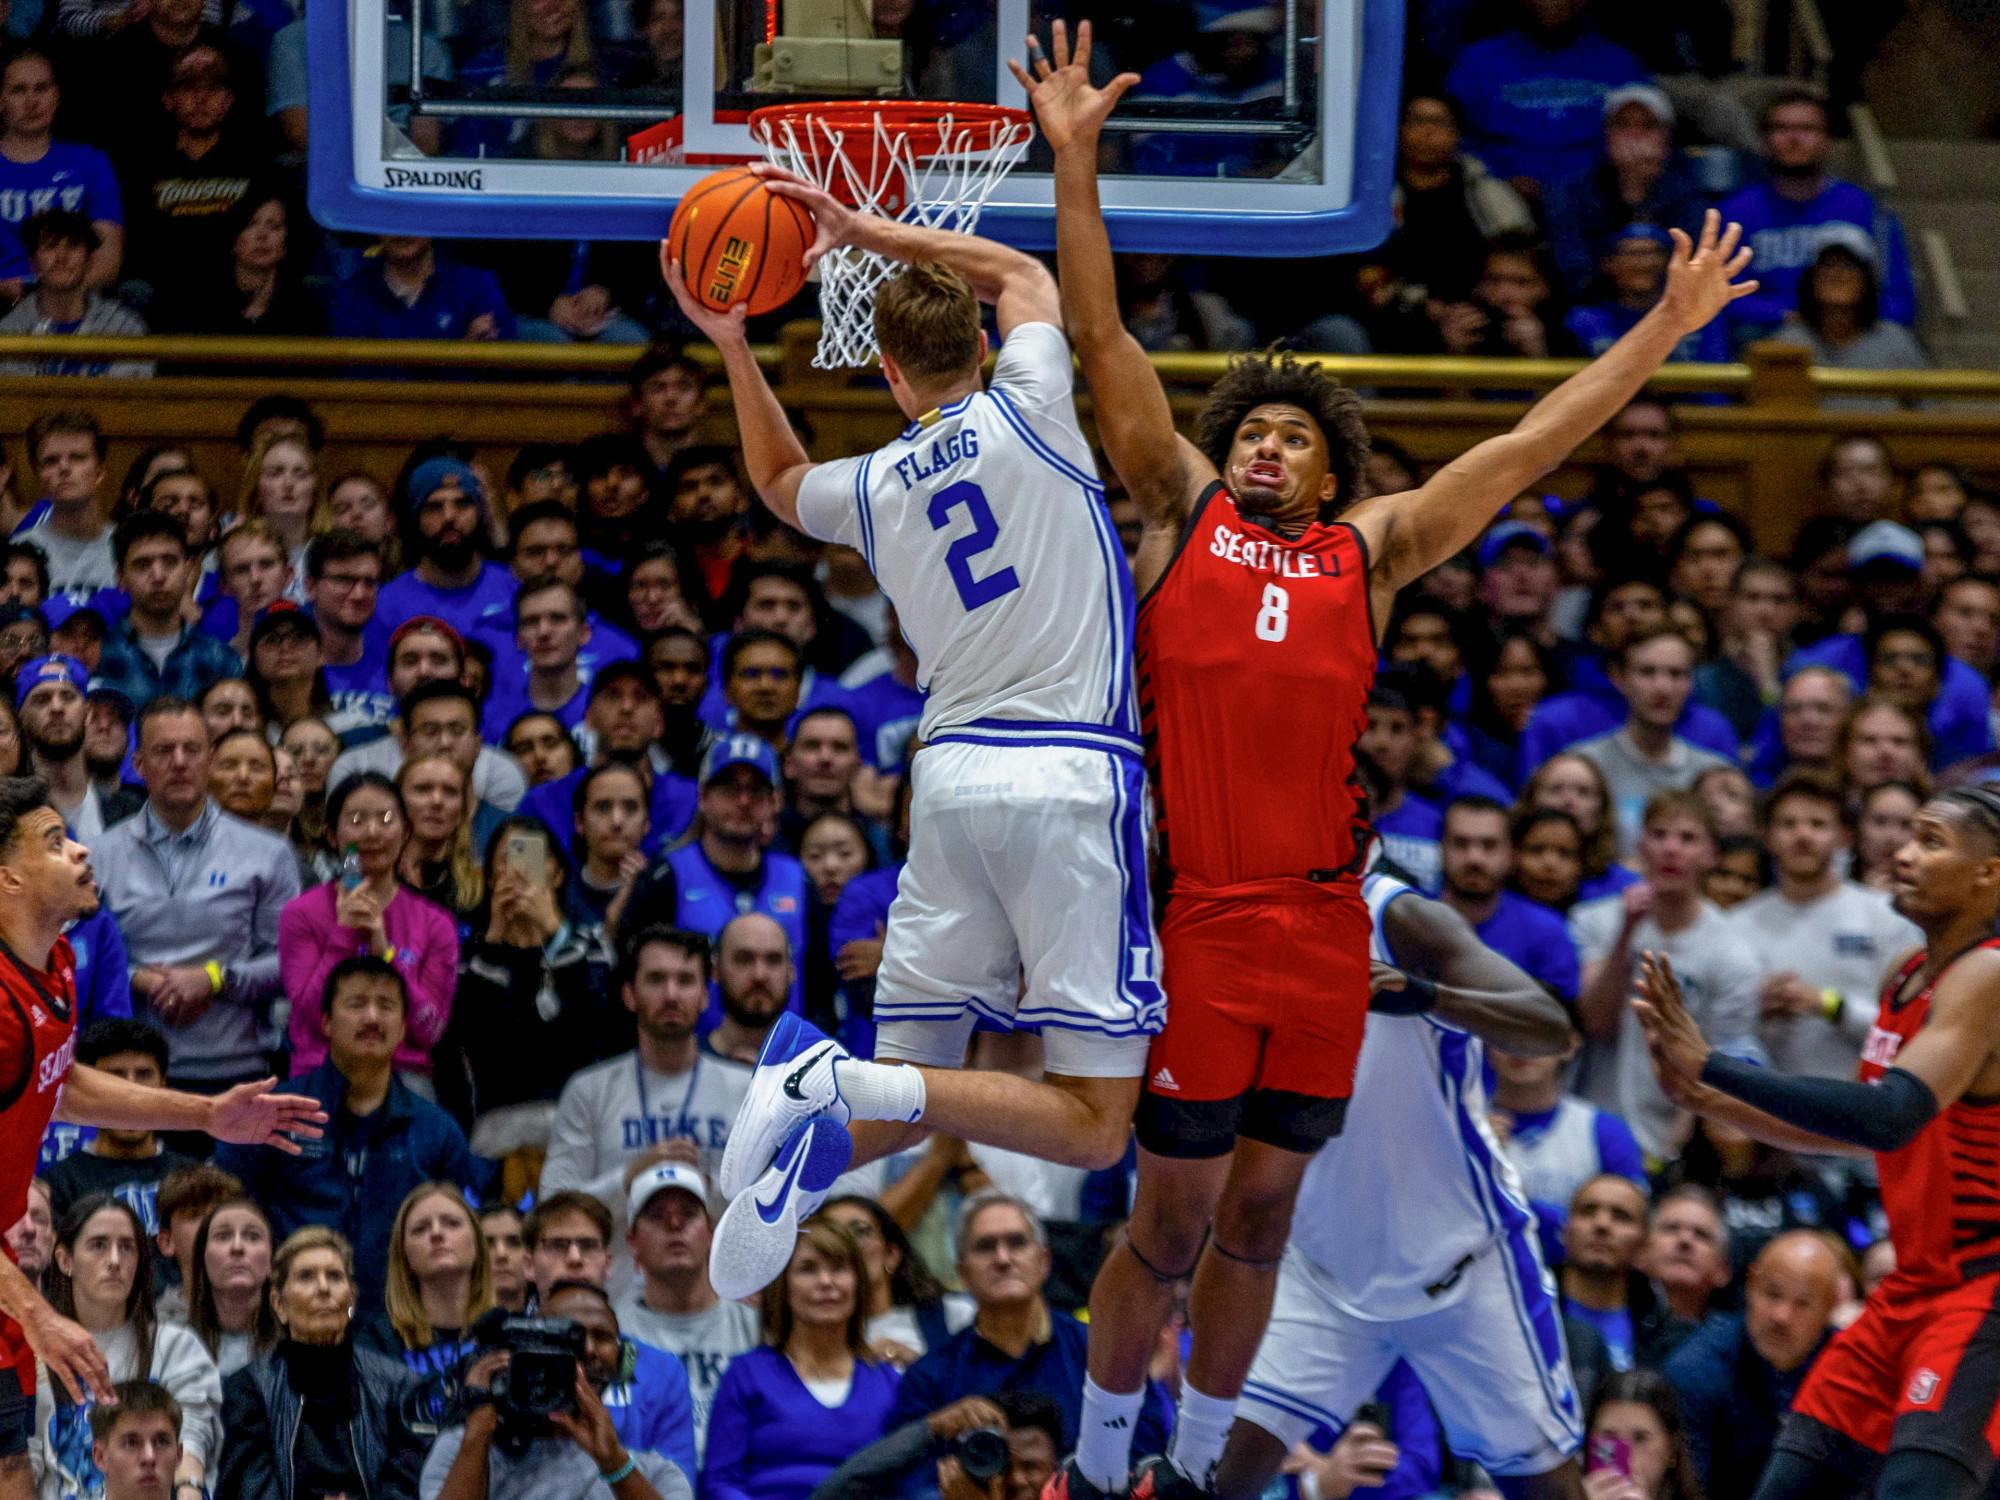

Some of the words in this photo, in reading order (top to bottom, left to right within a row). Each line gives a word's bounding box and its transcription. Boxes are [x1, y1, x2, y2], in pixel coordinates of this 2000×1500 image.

[384, 168, 482, 190] SPALDING
[710, 236, 749, 304] ELITE
[895, 428, 979, 491] FLAGG
[926, 479, 1021, 612] 2
[1255, 582, 1290, 643] 8
